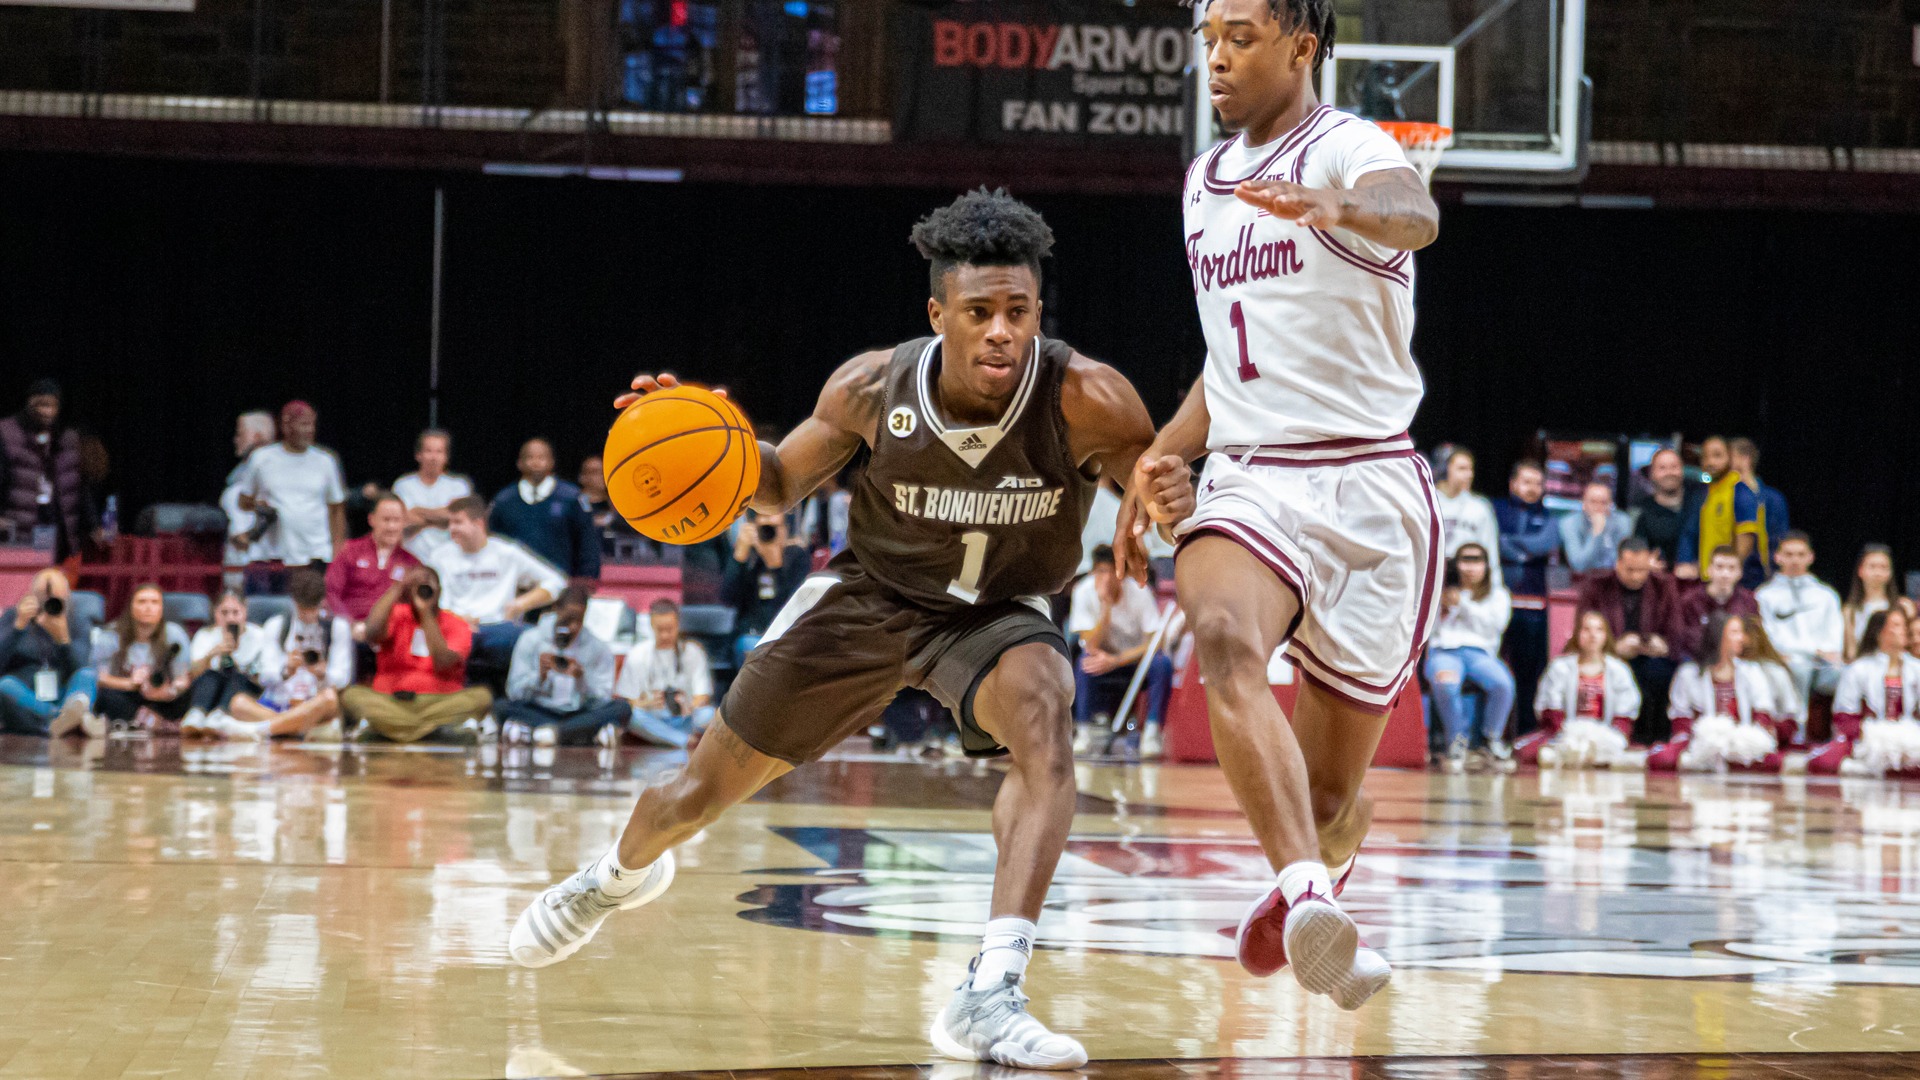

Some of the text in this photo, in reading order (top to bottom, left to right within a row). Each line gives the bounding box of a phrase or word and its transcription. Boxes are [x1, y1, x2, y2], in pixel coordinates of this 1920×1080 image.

[1071, 75, 1147, 96] Sports
[1001, 101, 1079, 132] FAN
[1186, 222, 1304, 296] Fordham
[1229, 301, 1260, 383] 1
[891, 413, 912, 432] 31
[958, 443, 987, 451] adidas
[892, 484, 1064, 525] ST. BONAVENTURE
[946, 531, 989, 605] 1
